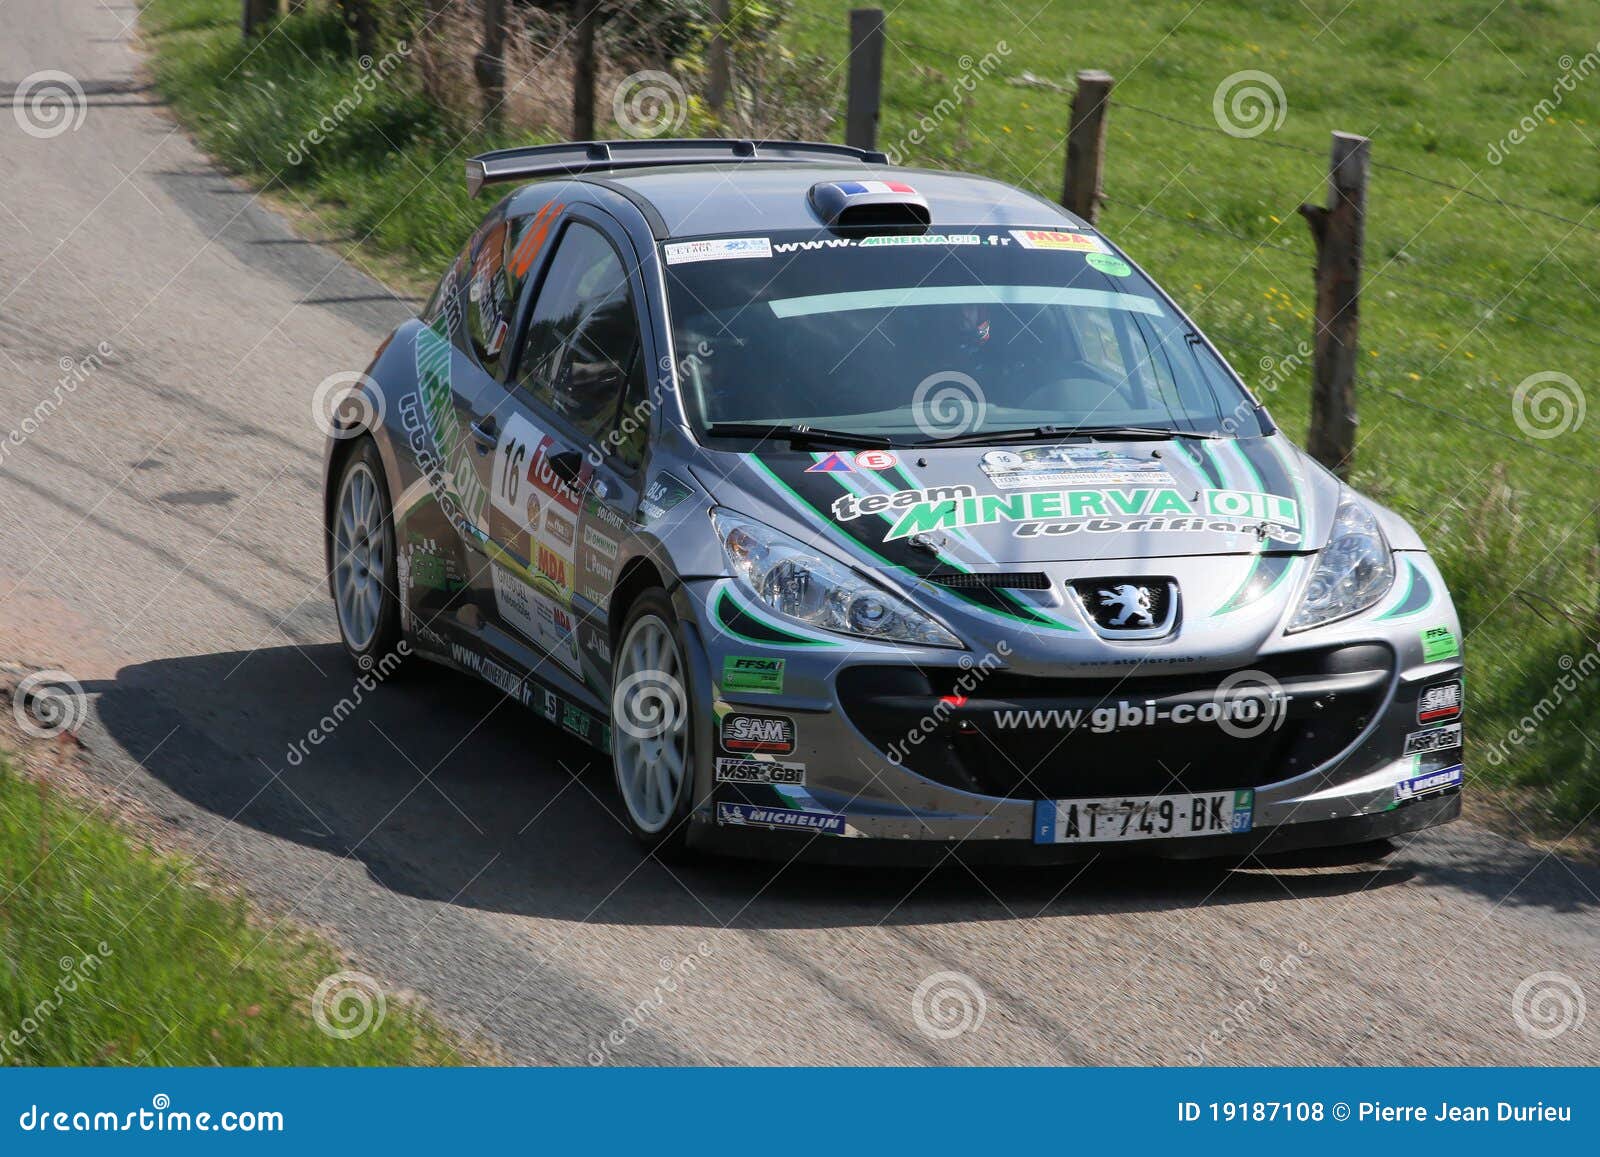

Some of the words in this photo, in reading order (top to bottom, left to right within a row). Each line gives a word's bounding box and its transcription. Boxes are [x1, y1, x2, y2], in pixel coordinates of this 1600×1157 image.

[501, 437, 527, 507] 16
[832, 485, 977, 523] team
[882, 489, 1196, 543] MINERVA
[1205, 488, 1301, 529] OIL
[735, 659, 776, 670] FFSA
[732, 716, 785, 742] SAM
[750, 808, 841, 829] MICHELIN
[1065, 796, 1226, 838] AT-749-BK
